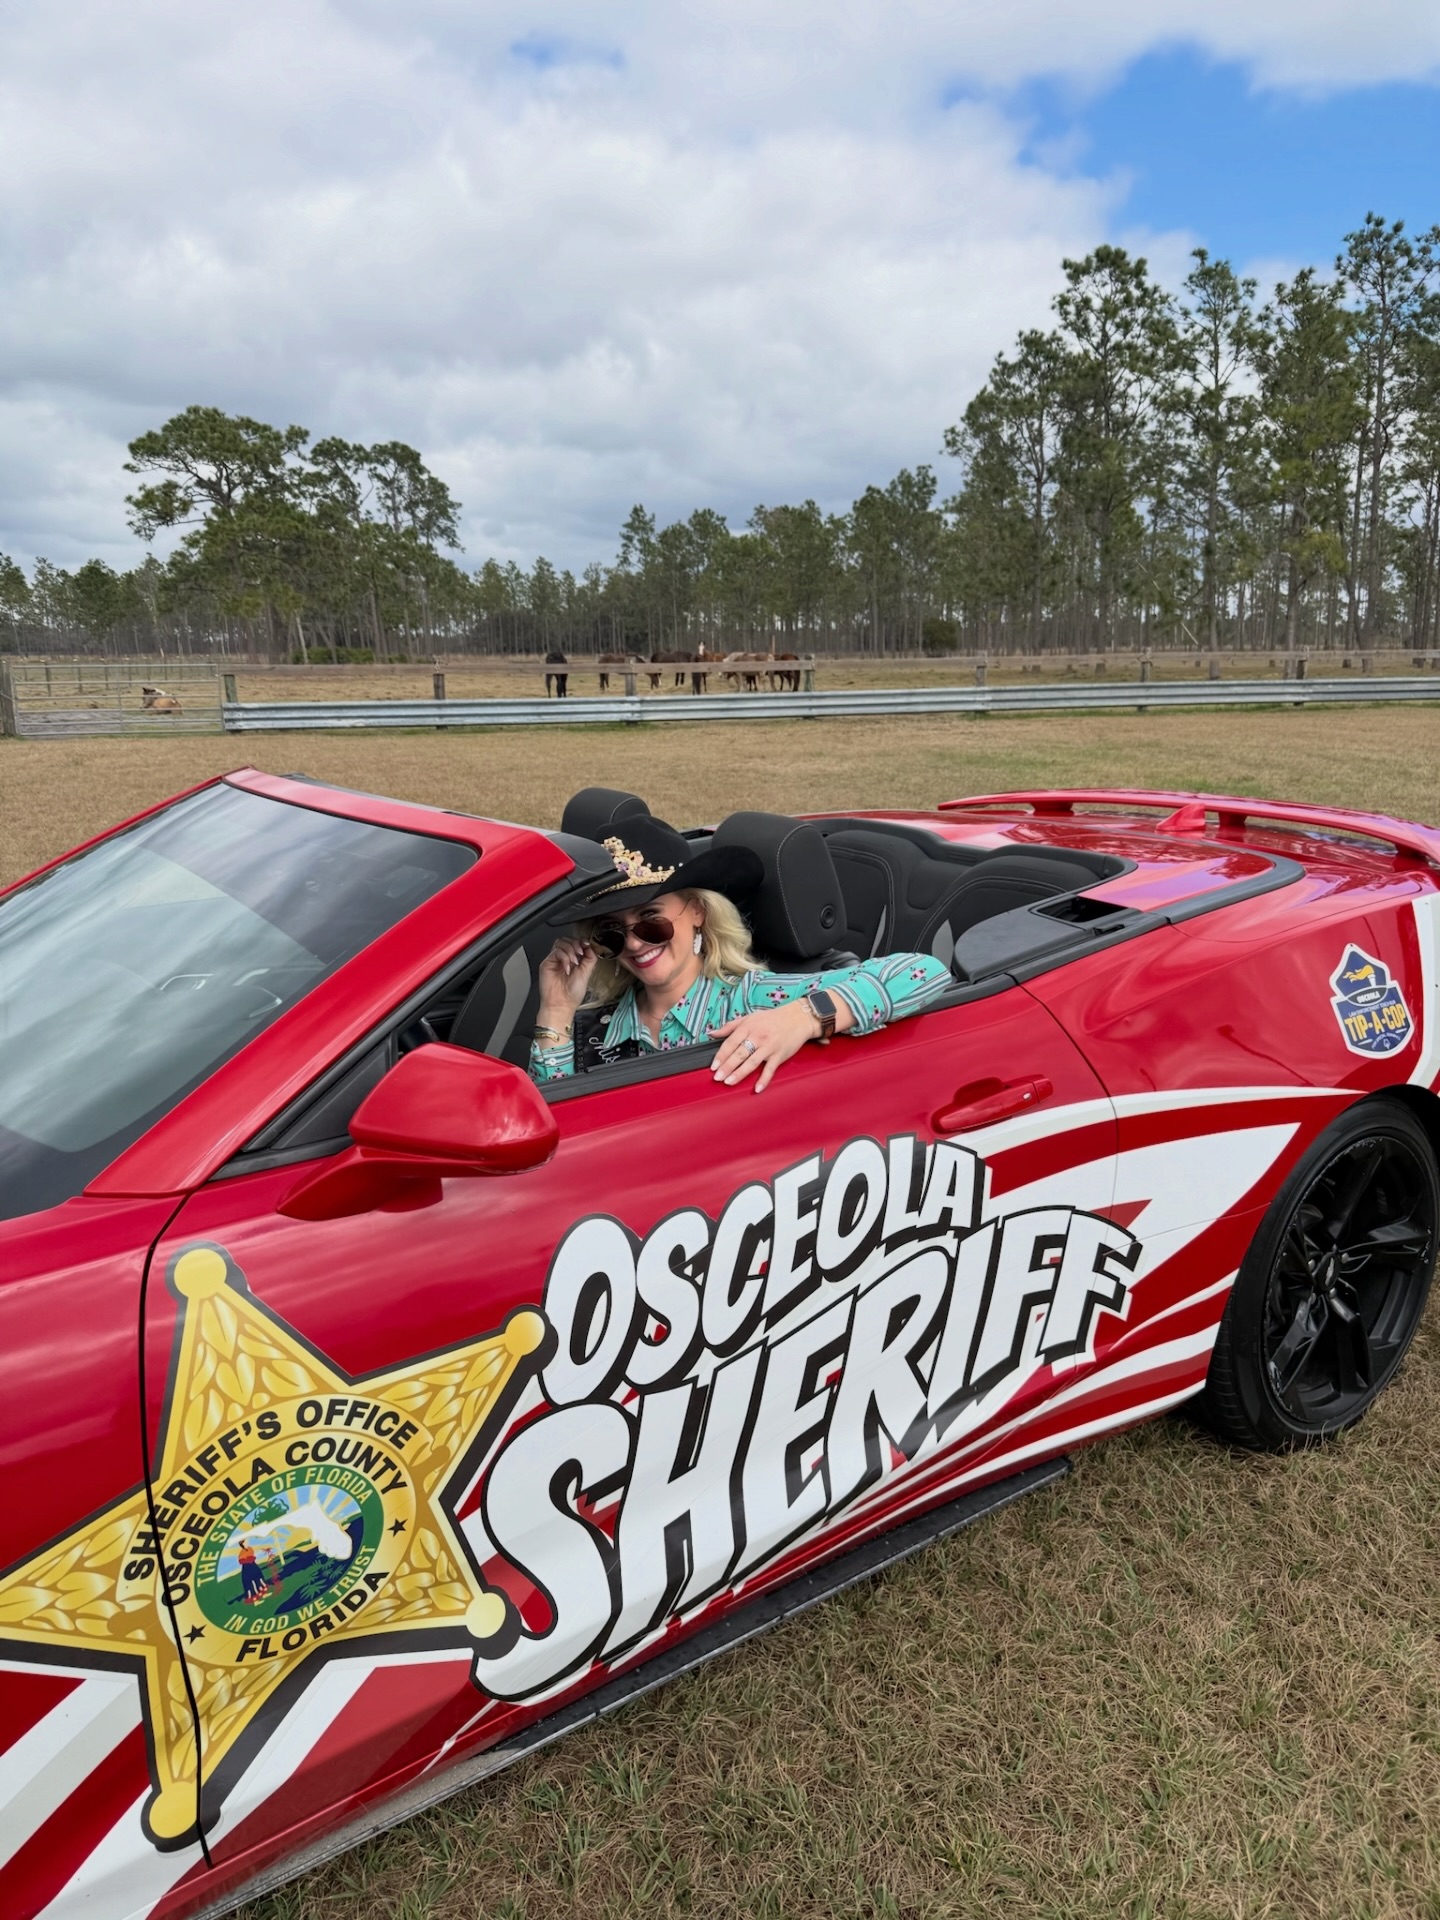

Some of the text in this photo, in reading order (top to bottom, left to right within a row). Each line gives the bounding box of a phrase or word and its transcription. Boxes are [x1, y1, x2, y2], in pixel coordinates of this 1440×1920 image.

[1344, 1003, 1406, 1042] TIP-A-COP
[542, 1133, 987, 1405] OSCEOLA
[123, 1398, 419, 1581] SHERIFF'S OFFICE
[161, 1437, 408, 1607] OSCEOLA COUNTY
[471, 1207, 1142, 1700] SHERIFF
[197, 1467, 374, 1588] THE STATE OF FLORIDA
[223, 1545, 376, 1634] IN GOD WE TRUST
[235, 1571, 389, 1662] FLORIDA
